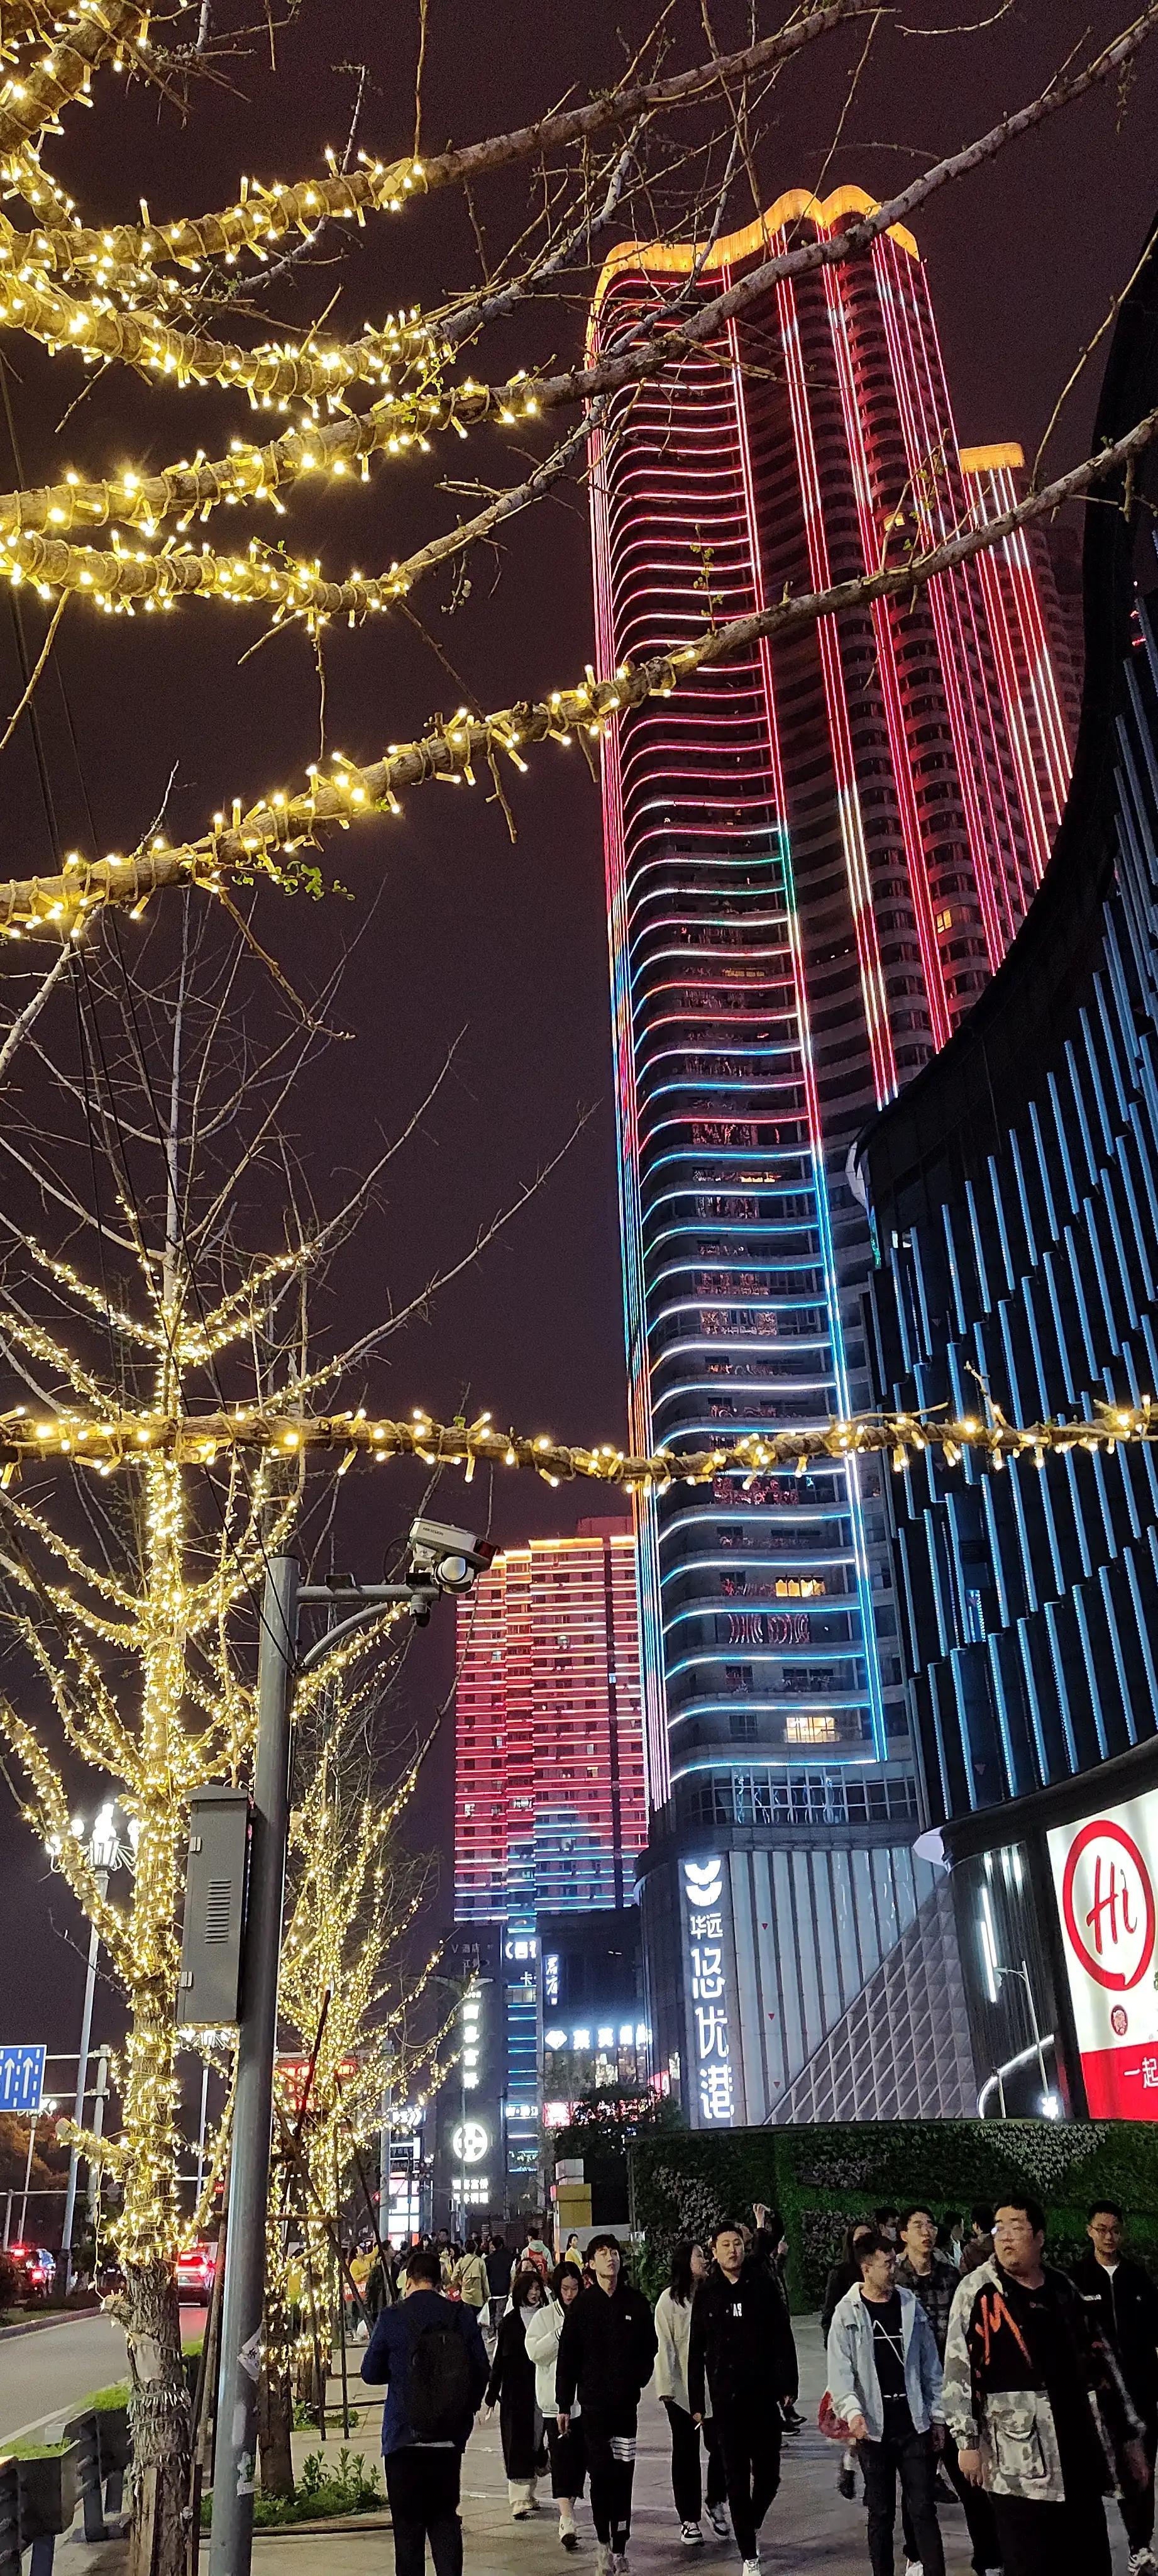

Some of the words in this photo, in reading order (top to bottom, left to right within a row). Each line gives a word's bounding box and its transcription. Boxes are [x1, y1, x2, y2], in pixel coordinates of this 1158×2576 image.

[690, 1913, 723, 1939] 华远
[1086, 1855, 1137, 1955] Hi
[691, 1947, 734, 2119] 悠优港
[1124, 2057, 1158, 2089] 一起
